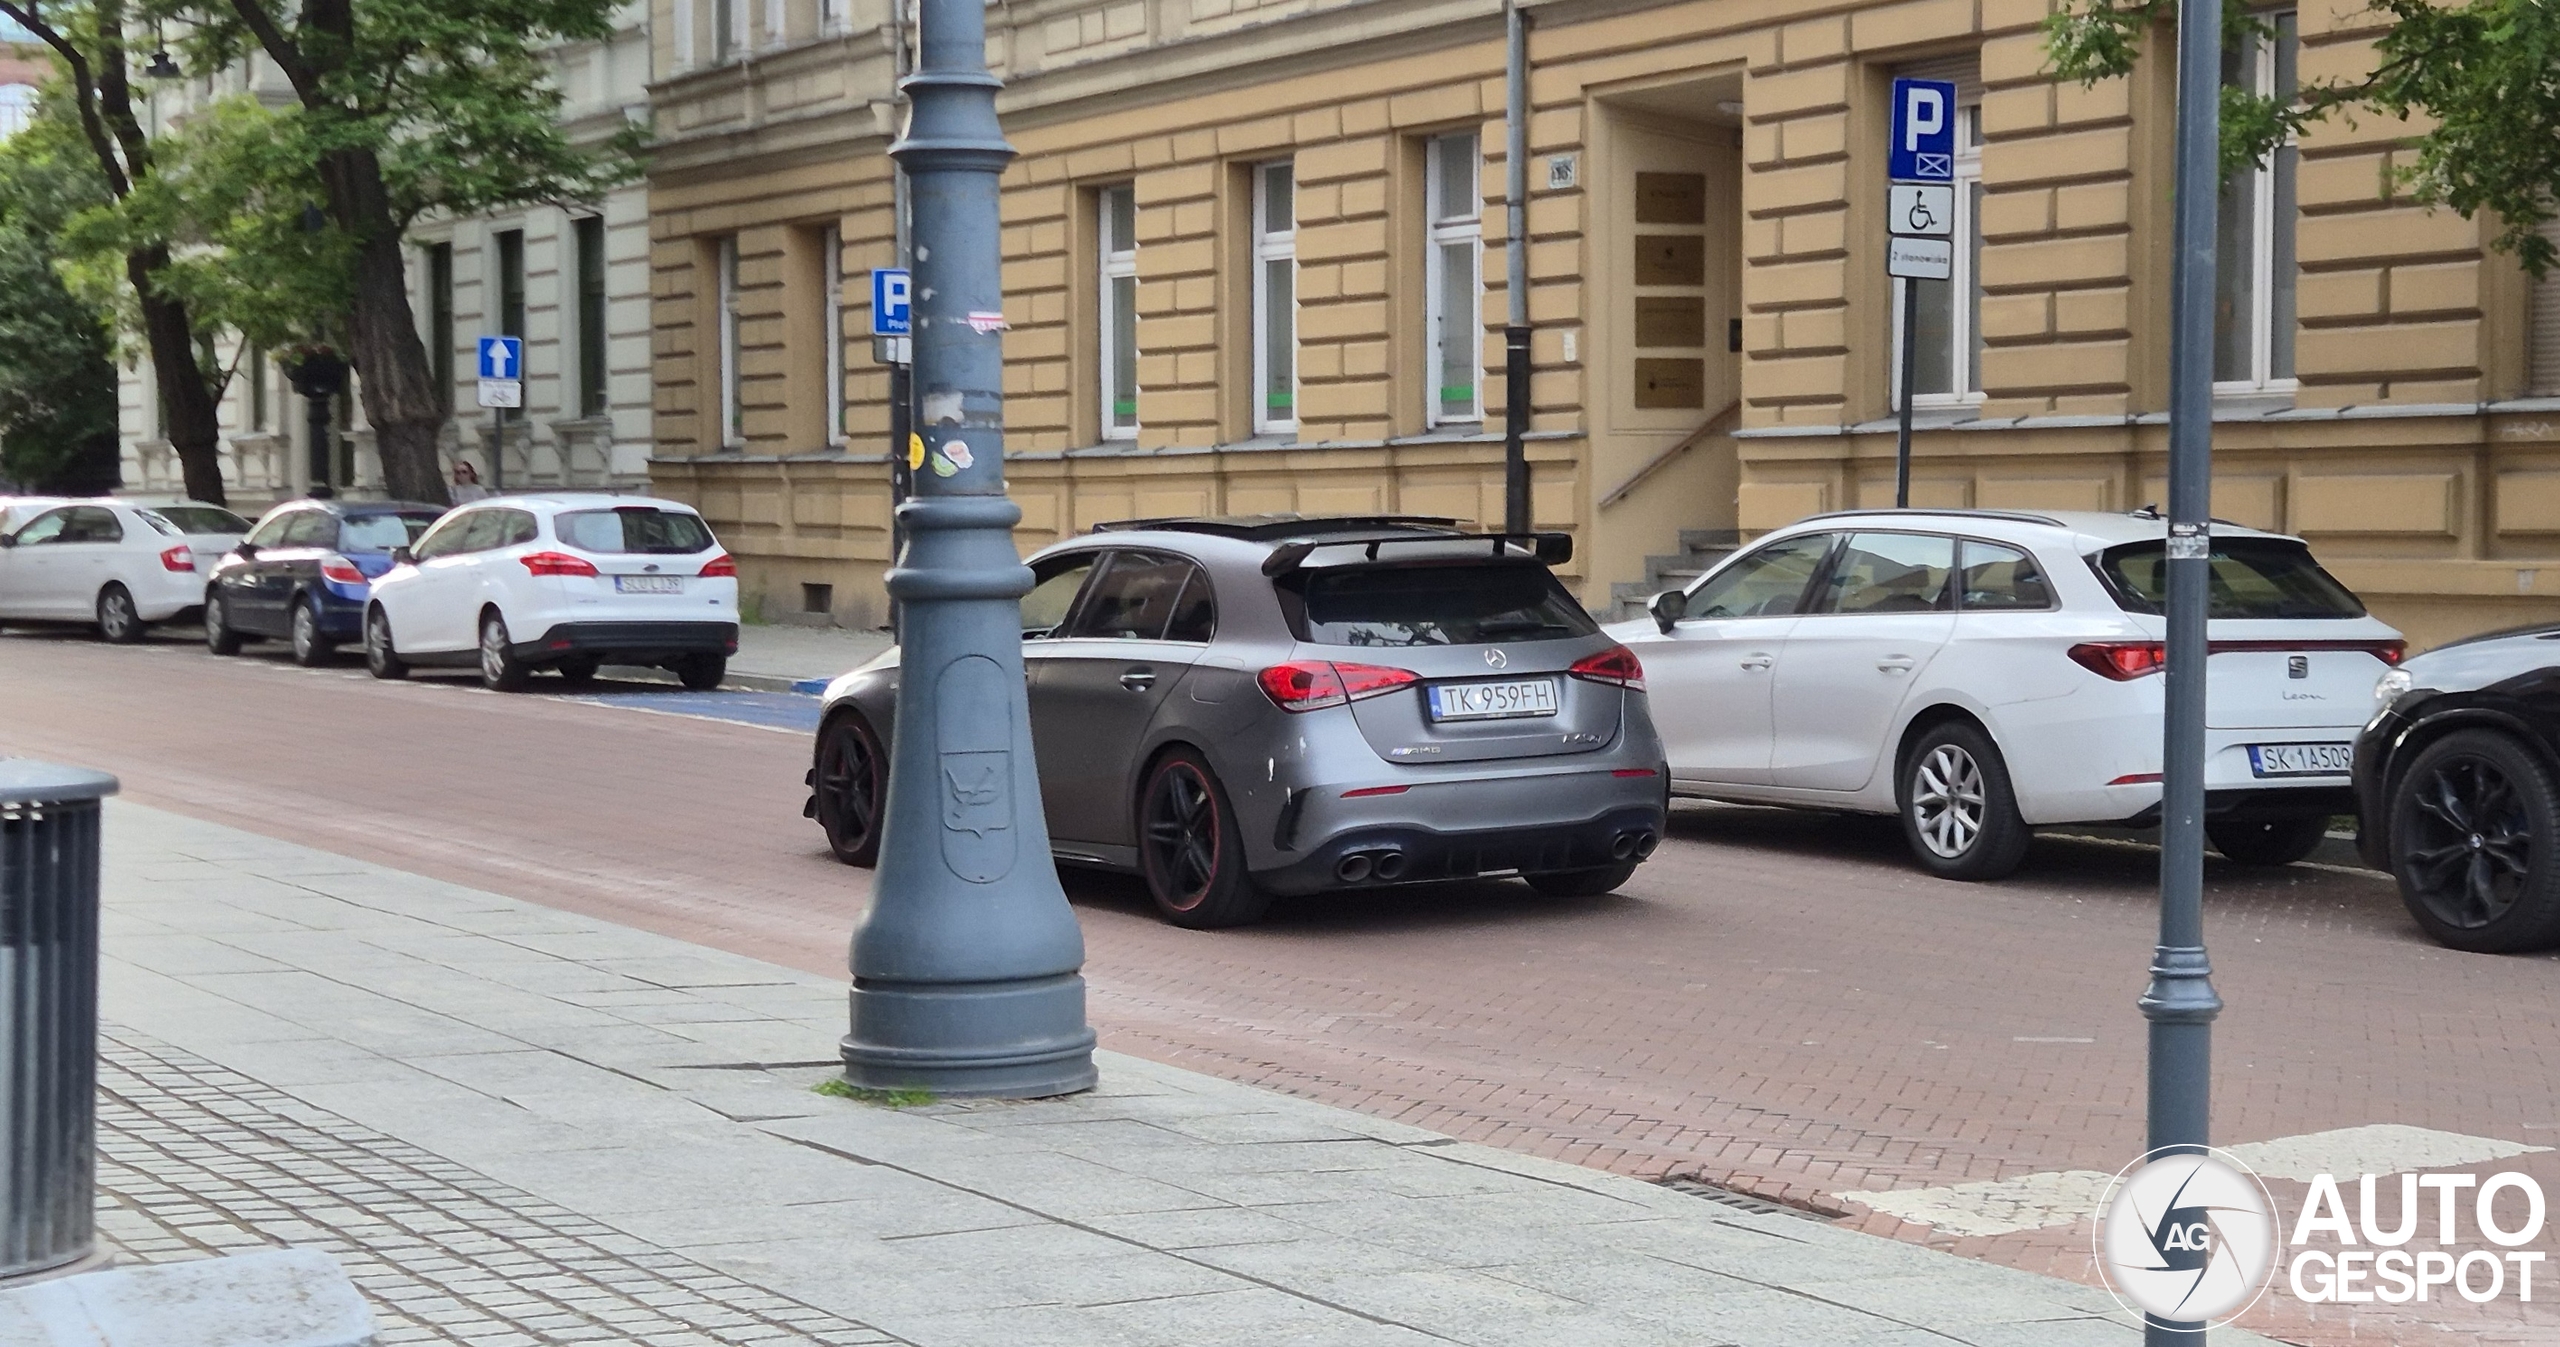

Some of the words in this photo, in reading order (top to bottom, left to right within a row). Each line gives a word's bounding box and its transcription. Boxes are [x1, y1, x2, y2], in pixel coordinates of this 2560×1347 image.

[1906, 87, 1943, 152] P
[883, 274, 911, 316] P
[1444, 686, 1475, 713] TK
[1481, 683, 1551, 712] 959FH
[2282, 691, 2326, 701] Leon
[2264, 747, 2292, 770] SK
[2296, 746, 2351, 770] 1A509
